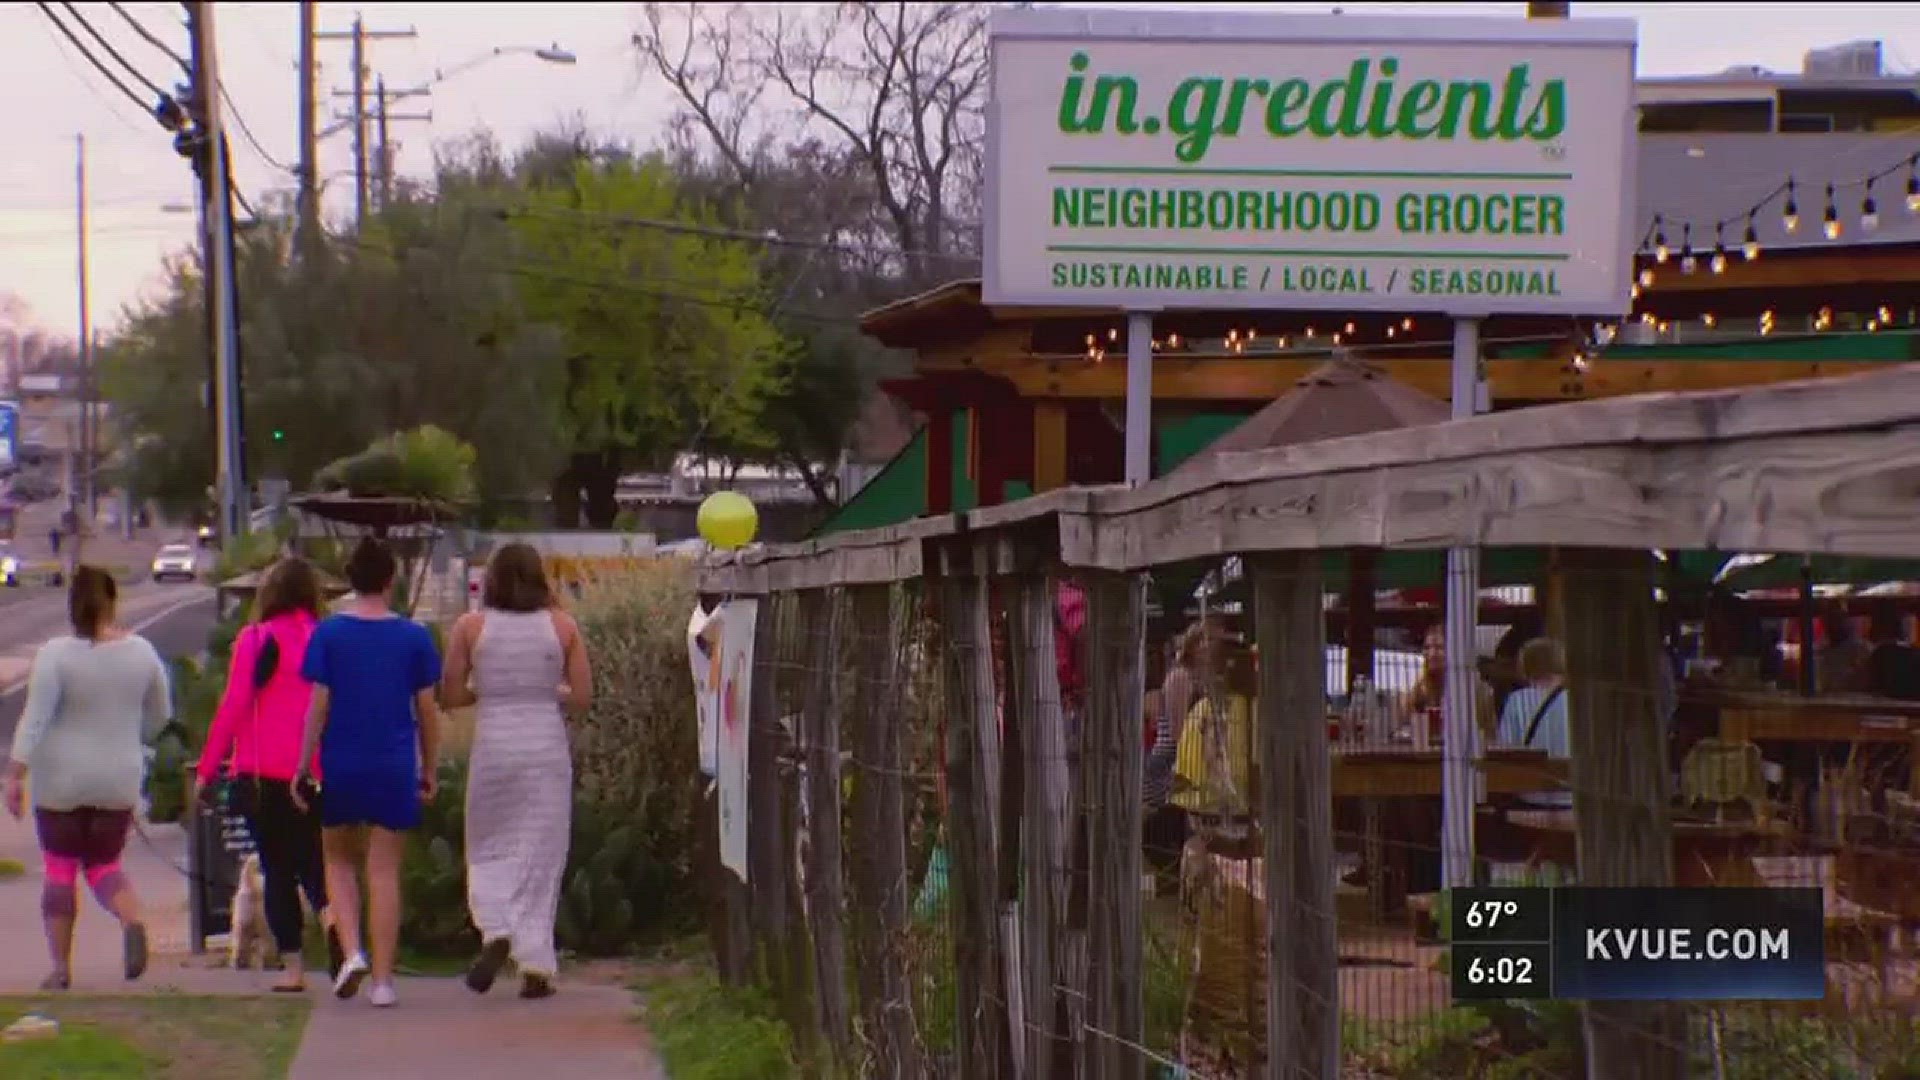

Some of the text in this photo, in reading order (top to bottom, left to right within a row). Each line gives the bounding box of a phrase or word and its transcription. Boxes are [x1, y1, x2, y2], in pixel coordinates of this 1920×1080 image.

[1058, 52, 1567, 162] in.gredients
[1052, 187, 1566, 235] NEIGHBORHOOD GROCER
[1053, 263, 1561, 296] SUSTAINABLE / LOCAL / SEASONAL
